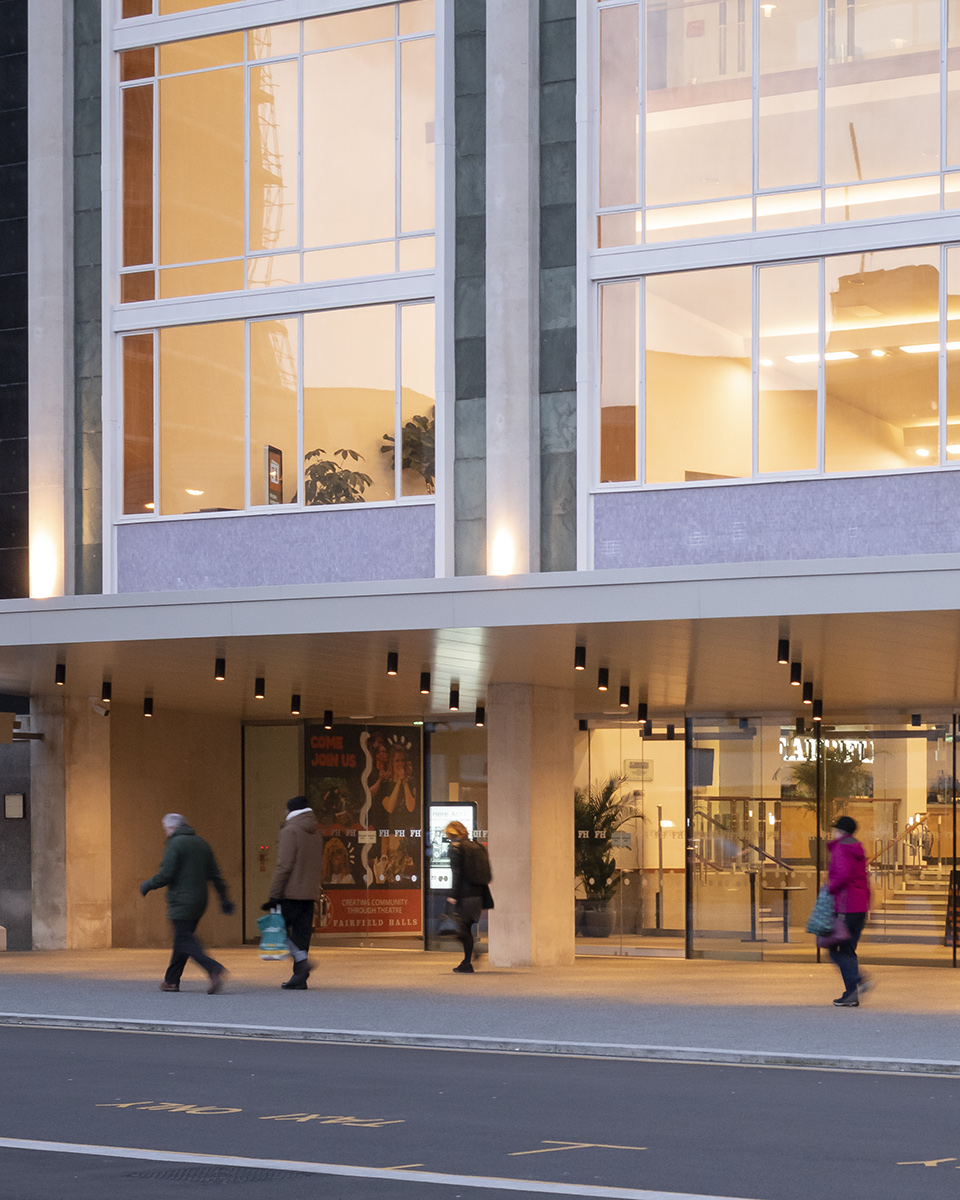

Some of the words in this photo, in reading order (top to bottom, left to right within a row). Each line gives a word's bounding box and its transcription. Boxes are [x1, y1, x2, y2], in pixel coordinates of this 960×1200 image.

[310, 736, 343, 749] COME
[311, 753, 339, 767] JOIN
[341, 754, 356, 768] US
[379, 829, 390, 837] FH
[394, 829, 405, 837] FH
[410, 829, 421, 837] FH
[578, 830, 589, 838] FH
[595, 830, 606, 838] FH
[333, 919, 384, 927] FAIRFIELD
